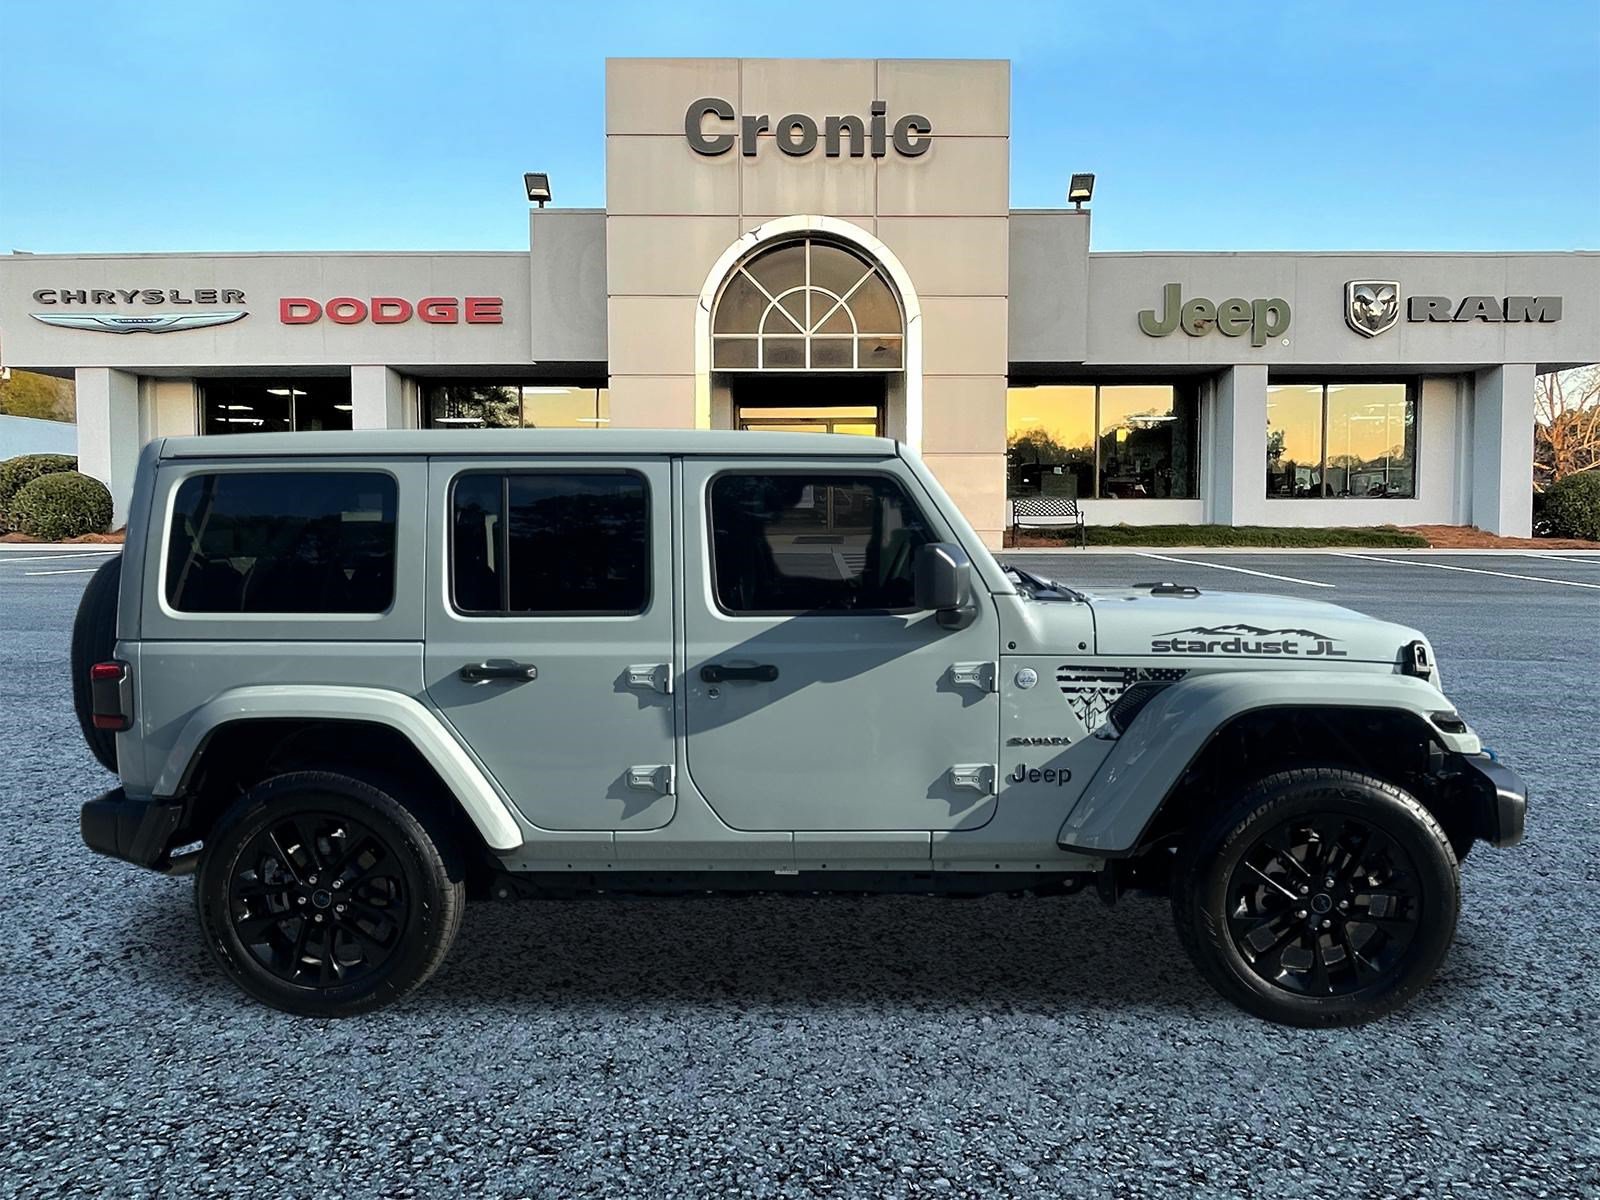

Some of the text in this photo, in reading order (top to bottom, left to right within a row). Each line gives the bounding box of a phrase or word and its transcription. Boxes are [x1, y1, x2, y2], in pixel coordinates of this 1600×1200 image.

[685, 97, 932, 158] Cronic
[33, 289, 246, 304] CHRYSLER
[1407, 296, 1563, 322] RAM
[280, 297, 503, 324] DODGE
[1138, 283, 1291, 347] Jeep
[1151, 637, 1347, 656] stardust JL
[1009, 763, 1072, 787] Jeep
